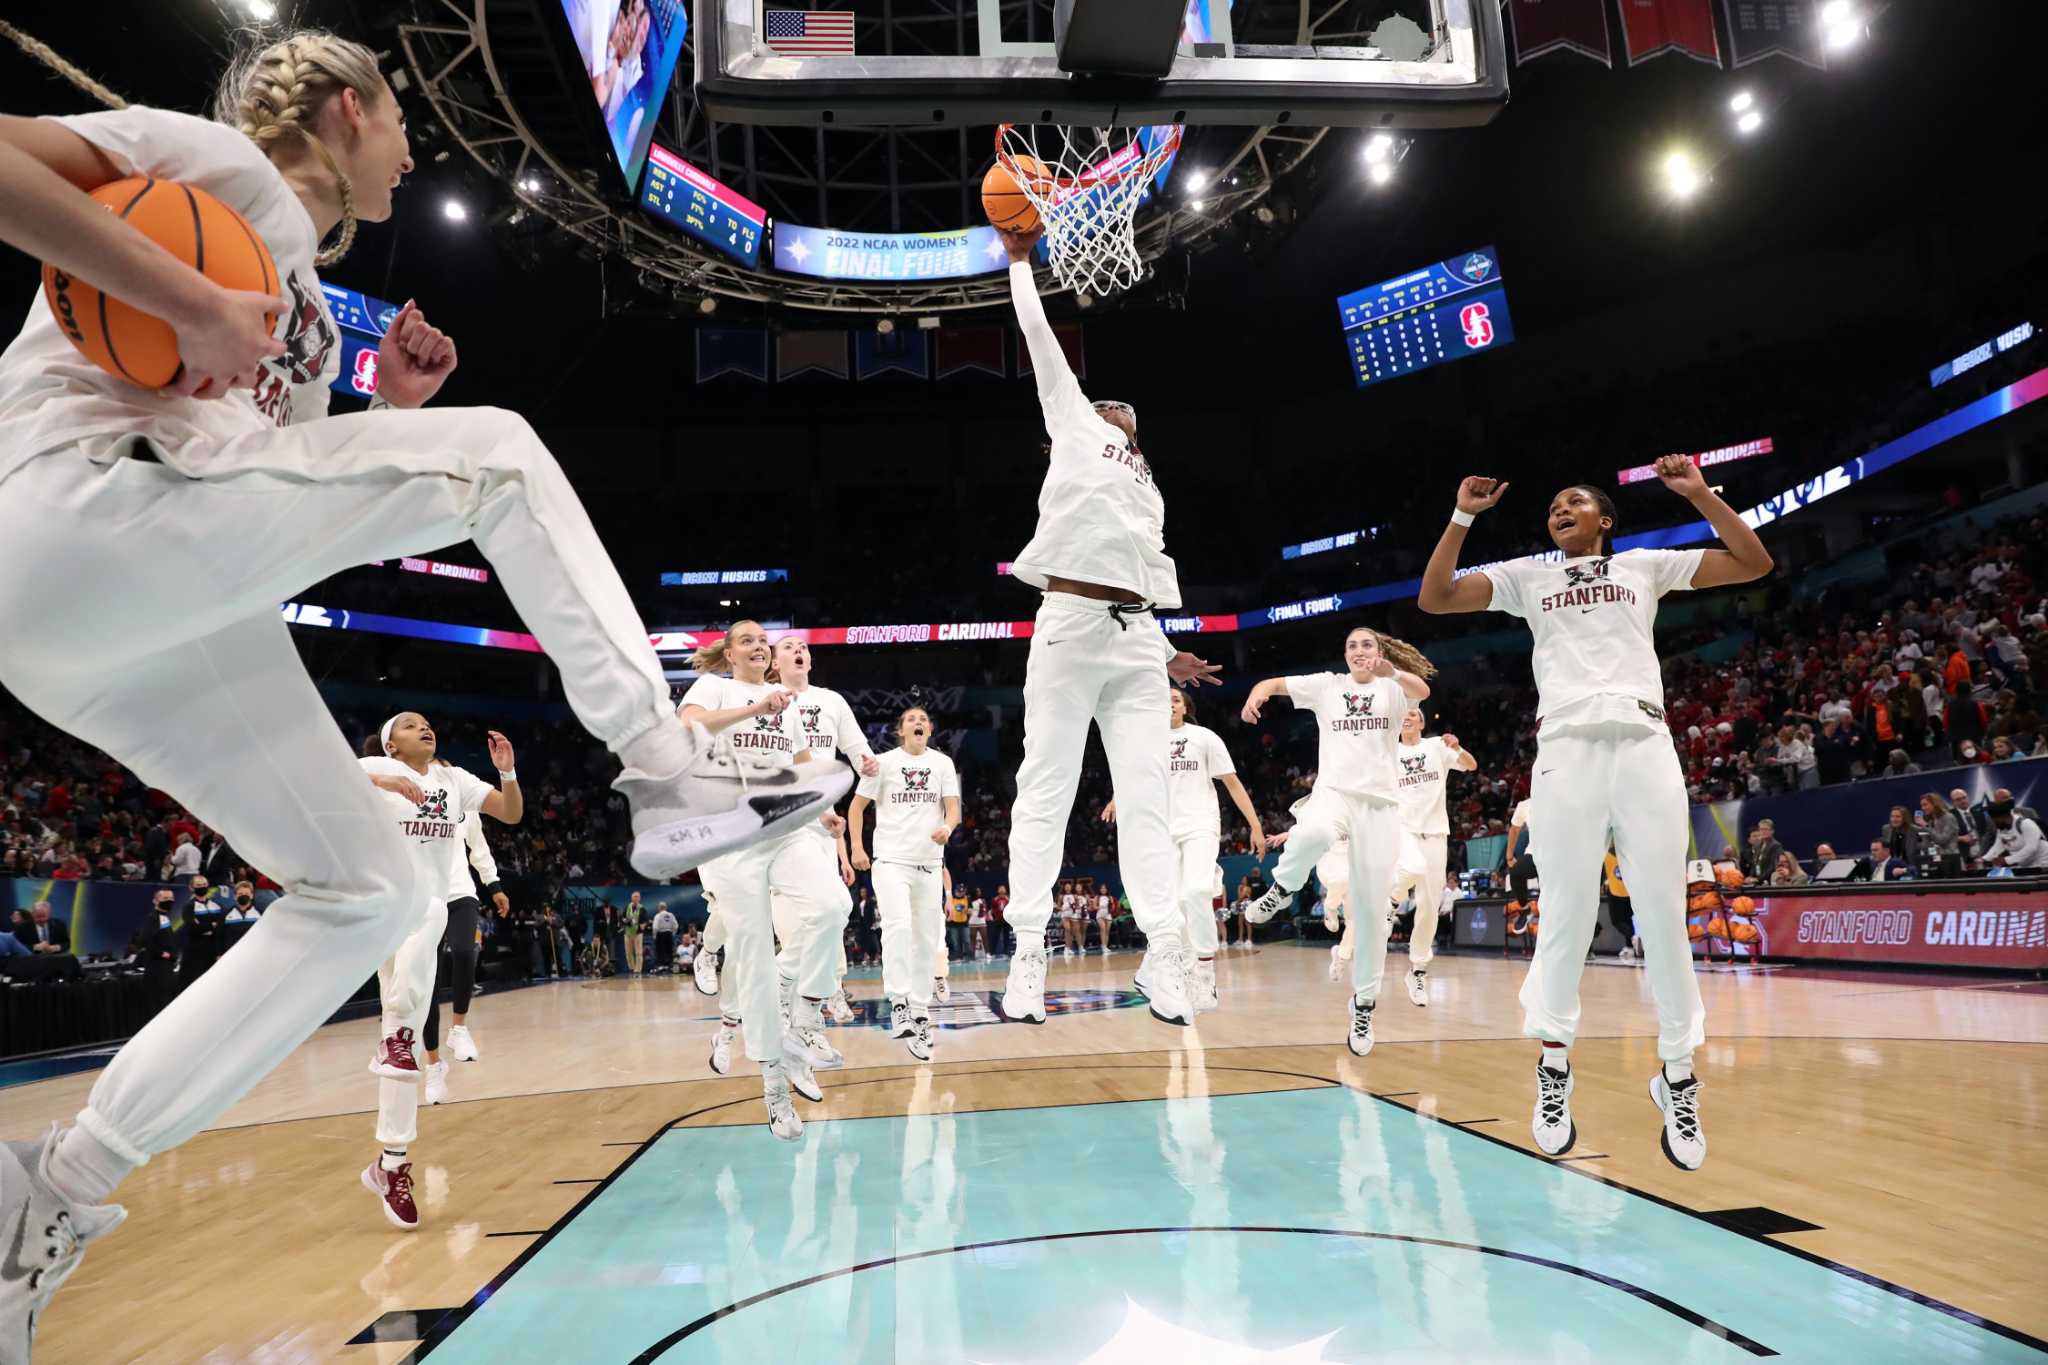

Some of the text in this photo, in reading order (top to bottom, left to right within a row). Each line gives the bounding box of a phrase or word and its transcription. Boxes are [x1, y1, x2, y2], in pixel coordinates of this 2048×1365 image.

[728, 218, 737, 230] TO
[729, 233, 736, 245] 4
[826, 235, 968, 250] 2022 NCAA WOMEN'S
[825, 251, 968, 277] FINAL FOUR
[431, 562, 481, 582] CARDINAL
[721, 570, 767, 583] HUSKIES
[1542, 584, 1636, 612] STANFORD
[1274, 596, 1334, 622] FINAL FOUR
[846, 622, 1014, 644] STANFORD CARDINAL
[1165, 617, 1196, 632] FOUR
[1332, 718, 1389, 732] STANFORD
[733, 733, 793, 753] STANFOR
[1798, 910, 2048, 947] STANFORD CARDINA
